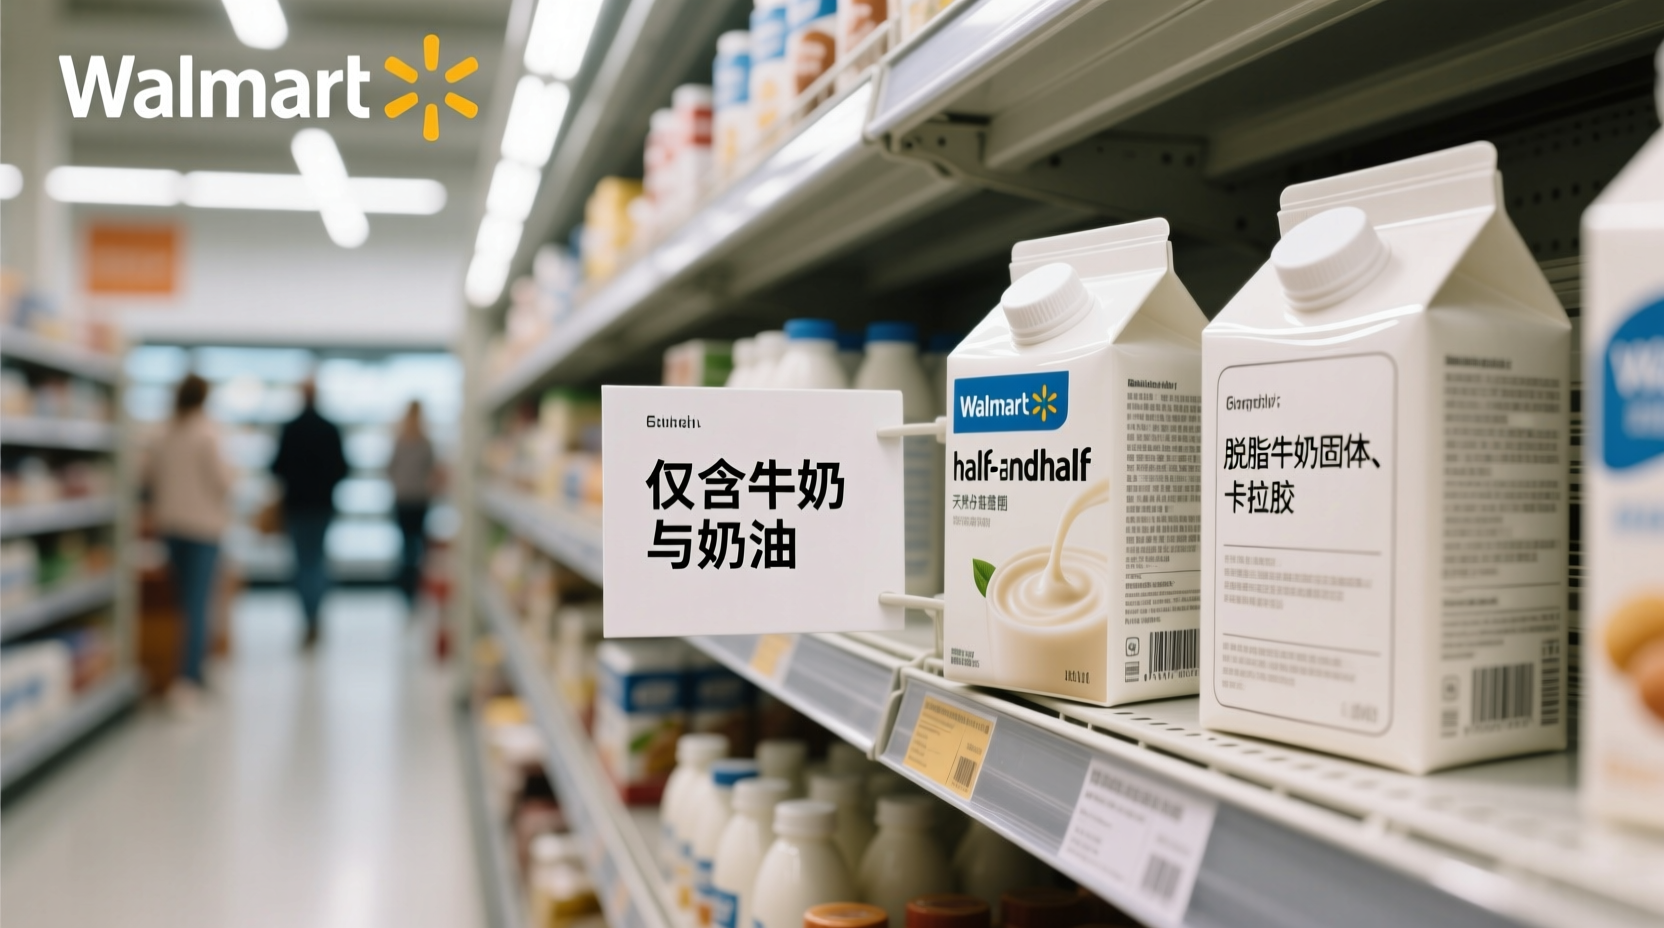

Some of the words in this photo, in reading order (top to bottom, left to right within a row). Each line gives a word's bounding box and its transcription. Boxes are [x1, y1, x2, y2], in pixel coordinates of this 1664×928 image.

[960, 392, 1030, 418] Walmart
[953, 447, 1092, 482] half-andhalf
[1223, 433, 1381, 470] 脱脂牛奶固体、
[645, 457, 845, 511] 仅含牛奶
[1224, 479, 1295, 514] 卡拉胶
[647, 518, 797, 570] 与奶油
